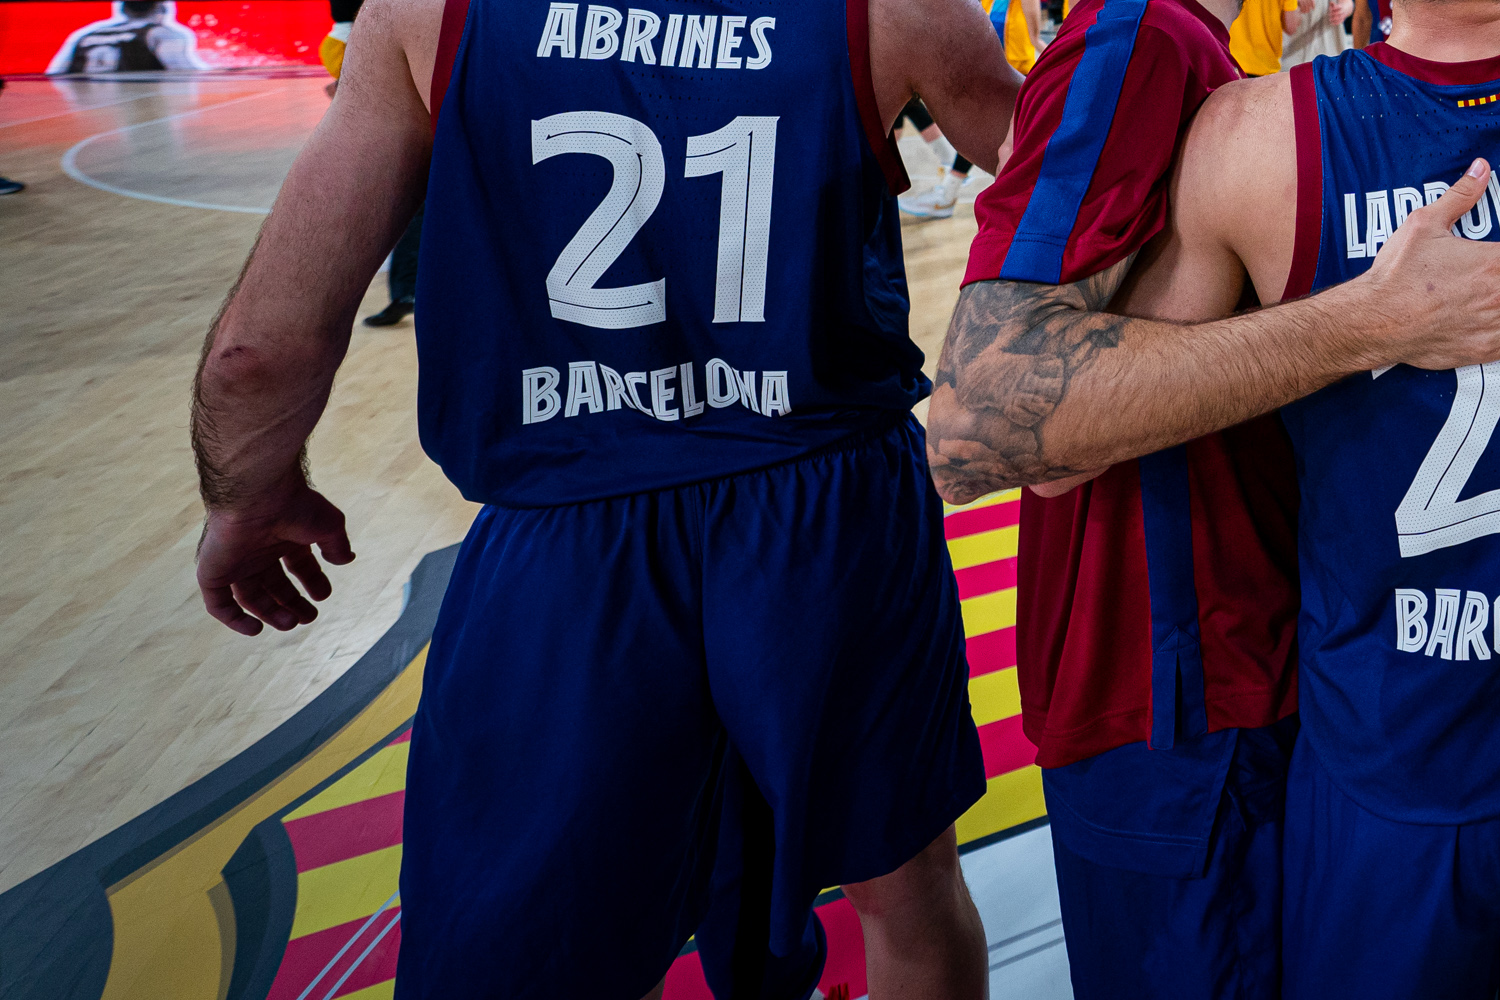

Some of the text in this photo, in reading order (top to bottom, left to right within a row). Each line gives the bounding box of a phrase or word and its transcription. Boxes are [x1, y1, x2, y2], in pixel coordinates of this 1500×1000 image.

[536, 2, 776, 70] ABRINES
[531, 111, 780, 329] 21
[522, 357, 792, 425] BARCELONA
